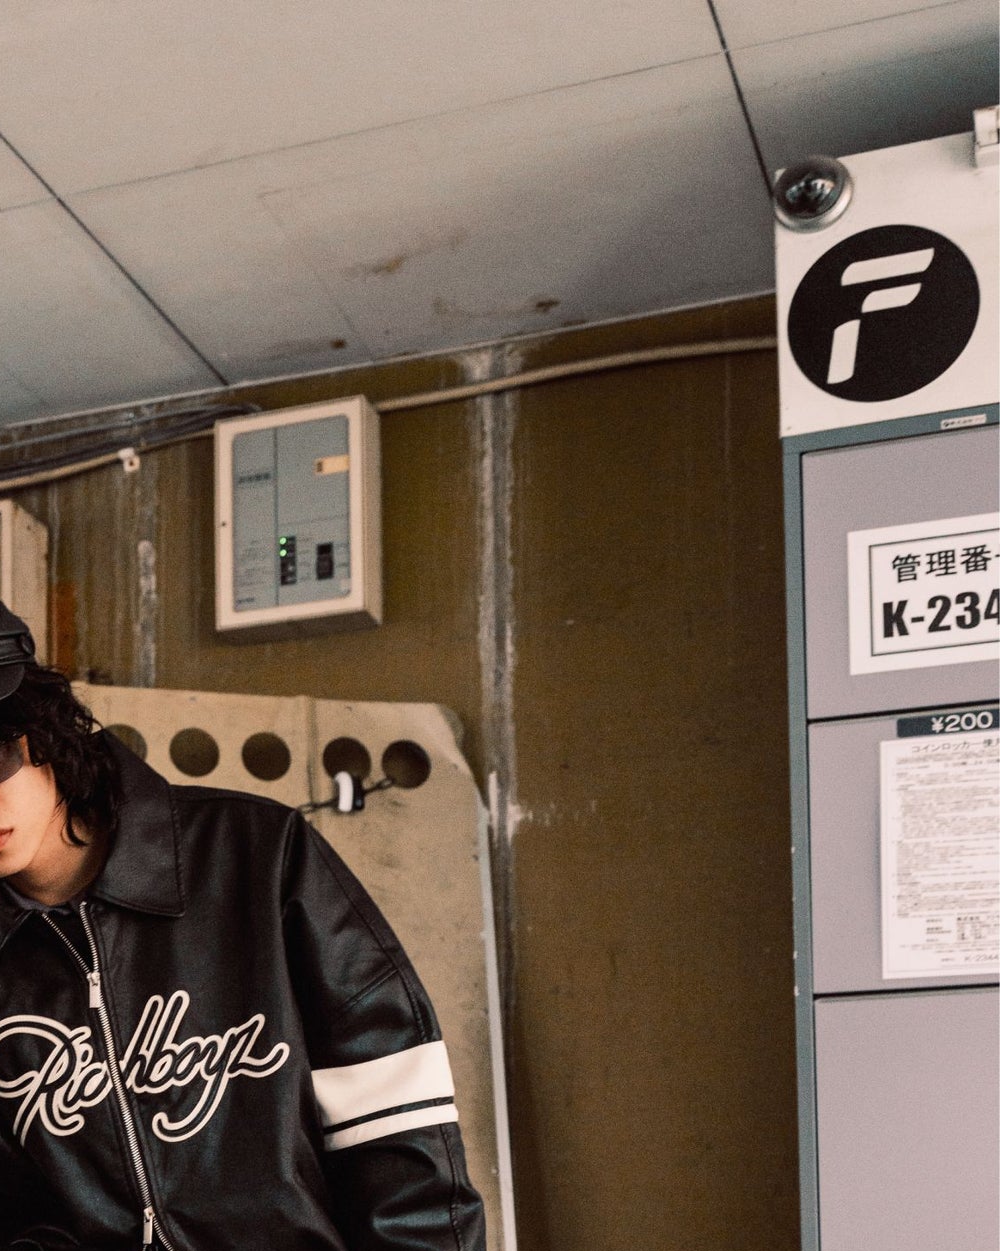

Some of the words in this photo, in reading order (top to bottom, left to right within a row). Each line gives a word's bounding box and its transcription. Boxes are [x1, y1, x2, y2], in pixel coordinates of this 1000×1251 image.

[891, 544, 999, 583] 管理番
[931, 711, 994, 733] ¥200
